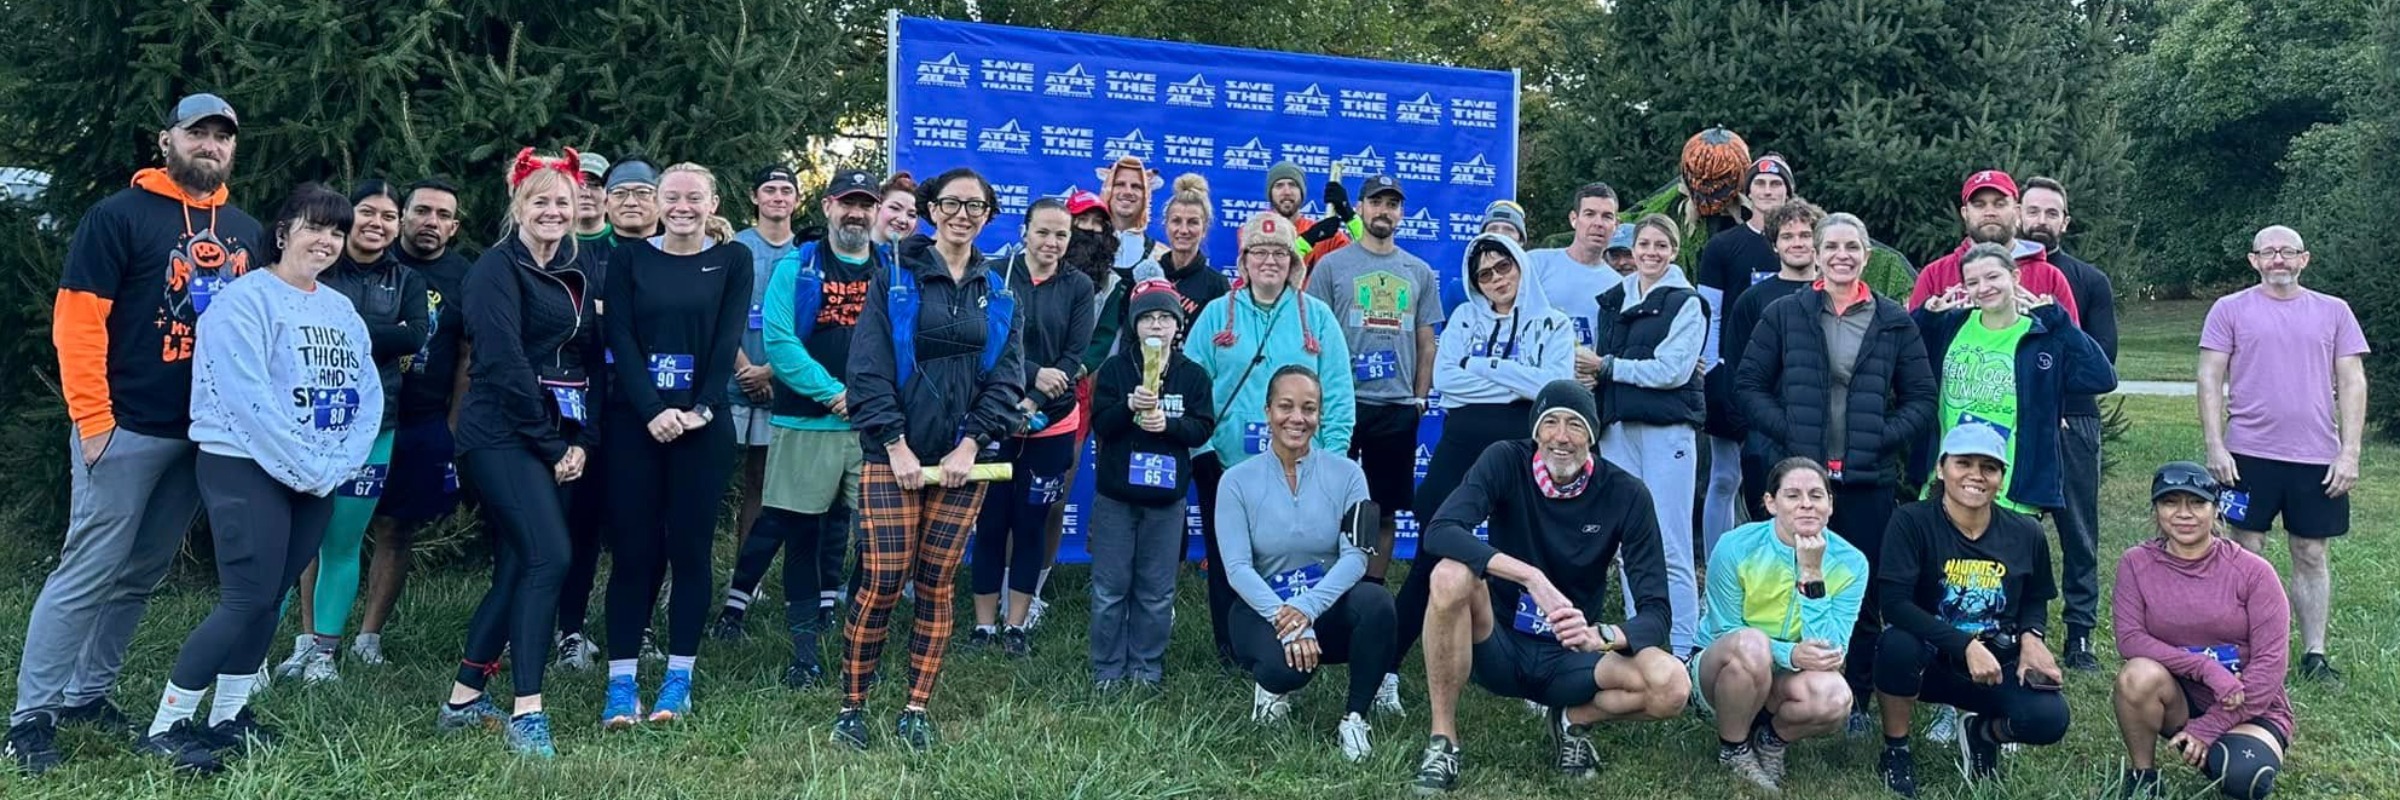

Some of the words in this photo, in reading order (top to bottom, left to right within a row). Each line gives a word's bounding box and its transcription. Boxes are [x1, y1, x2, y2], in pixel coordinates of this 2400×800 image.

[981, 59, 1034, 72] SAVE
[981, 70, 1034, 84] THE
[1106, 70, 1157, 82] SAVE
[981, 82, 1034, 92] TRAILS
[1106, 80, 1156, 94] THE
[1225, 80, 1274, 92] SAVE
[1106, 92, 1156, 102] TRAILS
[1225, 90, 1274, 104] THE
[1340, 90, 1387, 100] SAVE
[1225, 102, 1274, 111] TRAILS
[1340, 100, 1387, 112] THE
[1451, 98, 1497, 109] SAVE
[1340, 110, 1387, 120] TRAILS
[1451, 108, 1497, 121] THE
[913, 116, 968, 128] SAVE
[1452, 120, 1497, 128] TRAILS
[913, 127, 967, 140] THE
[1042, 126, 1093, 137] SAVE
[913, 139, 966, 148] TRAILS
[1042, 136, 1093, 149] THE
[1164, 134, 1214, 146] SAVE
[1042, 148, 1092, 158] TRAILS
[1164, 145, 1214, 158] THE
[1281, 144, 1330, 154] SAVE
[1164, 156, 1213, 166] TRAILS
[1282, 153, 1330, 166] THE
[1395, 151, 1442, 162] SAVE
[1395, 160, 1441, 174] THE
[1395, 172, 1441, 182] TRAILS
[991, 184, 1029, 194] AVE
[997, 195, 1028, 206] HE
[1450, 213, 1484, 222] SAV
[1449, 222, 1480, 234] TH
[823, 281, 866, 296] NIGH
[828, 295, 844, 304] OF
[171, 320, 191, 335] MY
[298, 326, 352, 348] THICK
[162, 335, 193, 362] LE
[297, 346, 360, 369] THIGHS
[319, 368, 345, 387] AND
[1369, 365, 1384, 378] 93
[1974, 365, 2016, 385] LOGA
[656, 372, 675, 388] 90
[1954, 380, 2003, 402] INVITE
[330, 408, 346, 424] 80
[1144, 469, 1162, 485] 65
[354, 481, 374, 496] 67
[1042, 490, 1057, 504] 72
[1394, 518, 1419, 530] TH
[1944, 558, 2007, 577] HAUNTED
[1944, 574, 1971, 588] TRAIL
[1977, 576, 2001, 588] RUN
